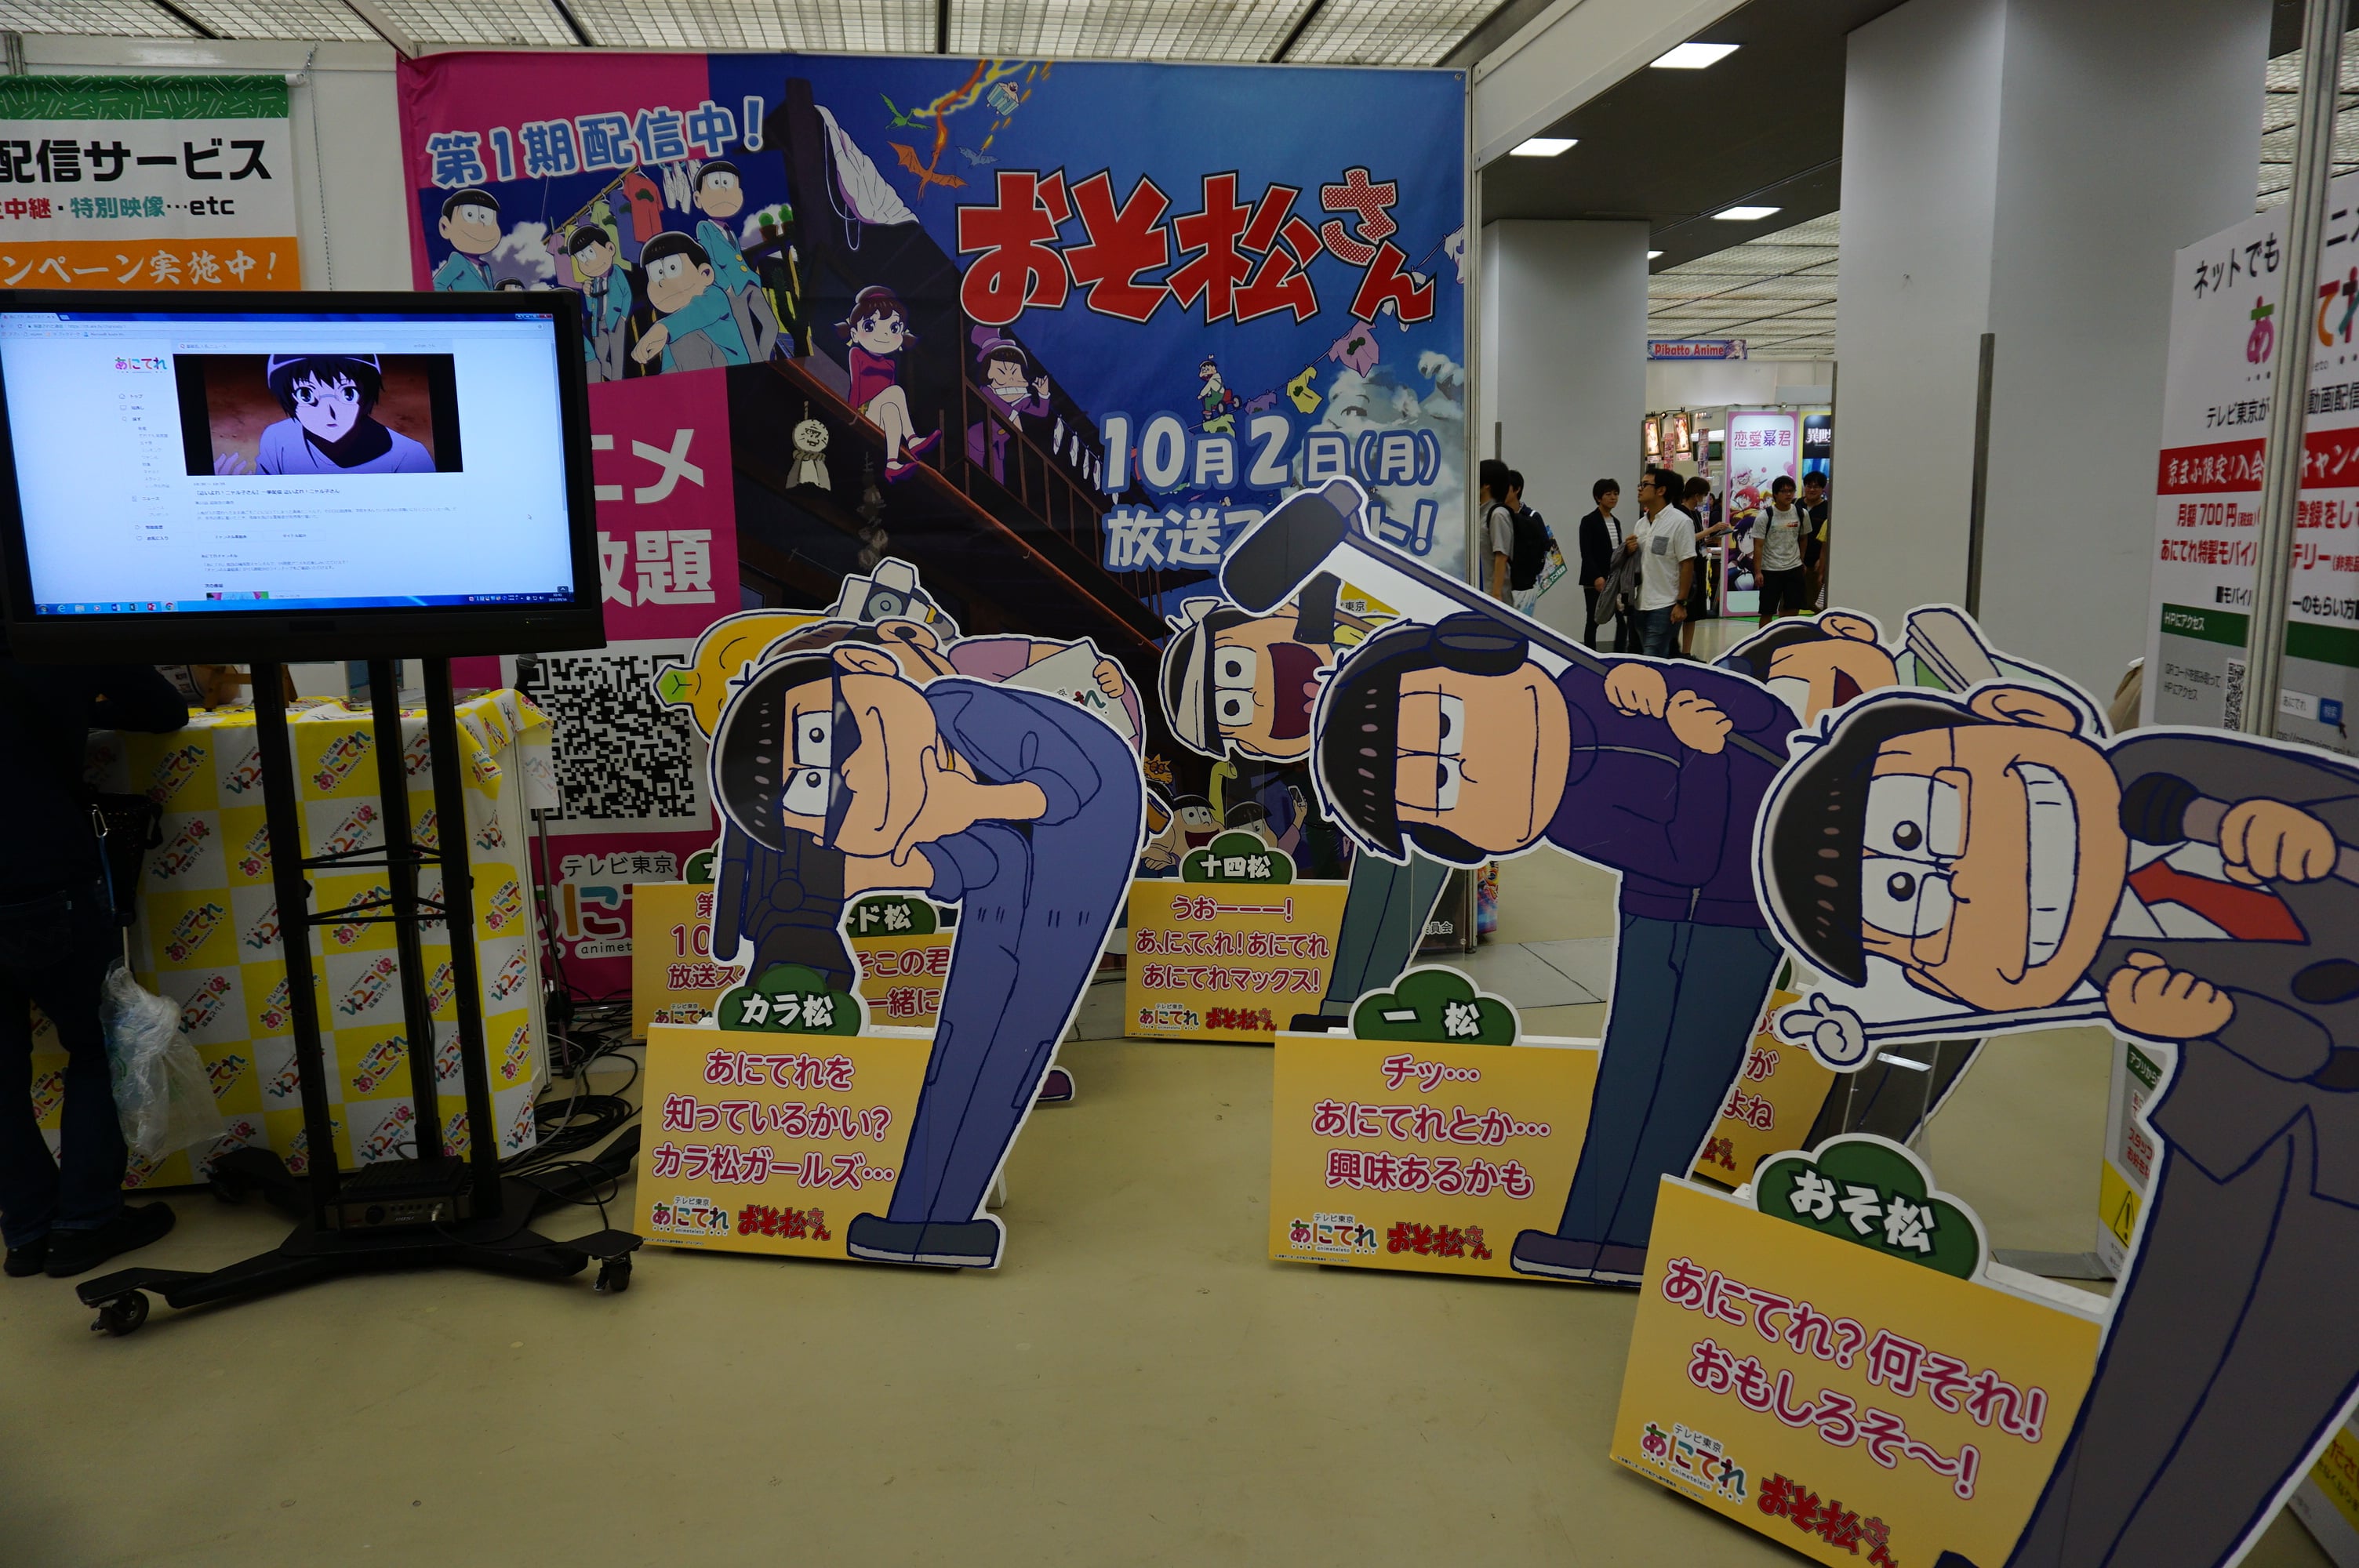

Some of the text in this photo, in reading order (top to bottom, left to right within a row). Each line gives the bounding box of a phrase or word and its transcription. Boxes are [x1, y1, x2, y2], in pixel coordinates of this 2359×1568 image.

[0, 138, 272, 183] 配信サービス
[956, 165, 1436, 326] おそ松さん
[2194, 231, 2280, 299] ネットでも
[115, 357, 167, 369] あにてれ
[1655, 343, 1724, 355] Pikatto Anime
[1102, 414, 1440, 489] 10月2日(月)
[1734, 430, 1791, 447] 恋愛暴君
[565, 855, 674, 877] テレビ東京
[1200, 855, 1271, 879] 十四松
[1143, 963, 1321, 993] あにてれマックス!
[742, 993, 834, 1029] カラ松
[1140, 1007, 1278, 1032] あにてれ おそ松さん
[704, 1049, 856, 1091] あにてれを
[663, 1094, 892, 1142] 知っているかい?
[1325, 1149, 1535, 1200] 興味あるかも
[674, 1196, 710, 1206] テレビ東京
[1314, 1214, 1354, 1223] テレビ東京
[1792, 1169, 1938, 1254] おそ松
[652, 1202, 831, 1241] あにてれ おそ松さん
[1290, 1220, 1492, 1260] あにてれ おそ松さん
[1674, 1425, 1723, 1454] テレビ東京
[1642, 1423, 1746, 1496] あにてれ
[1757, 1473, 1899, 1568] おそ松さん
